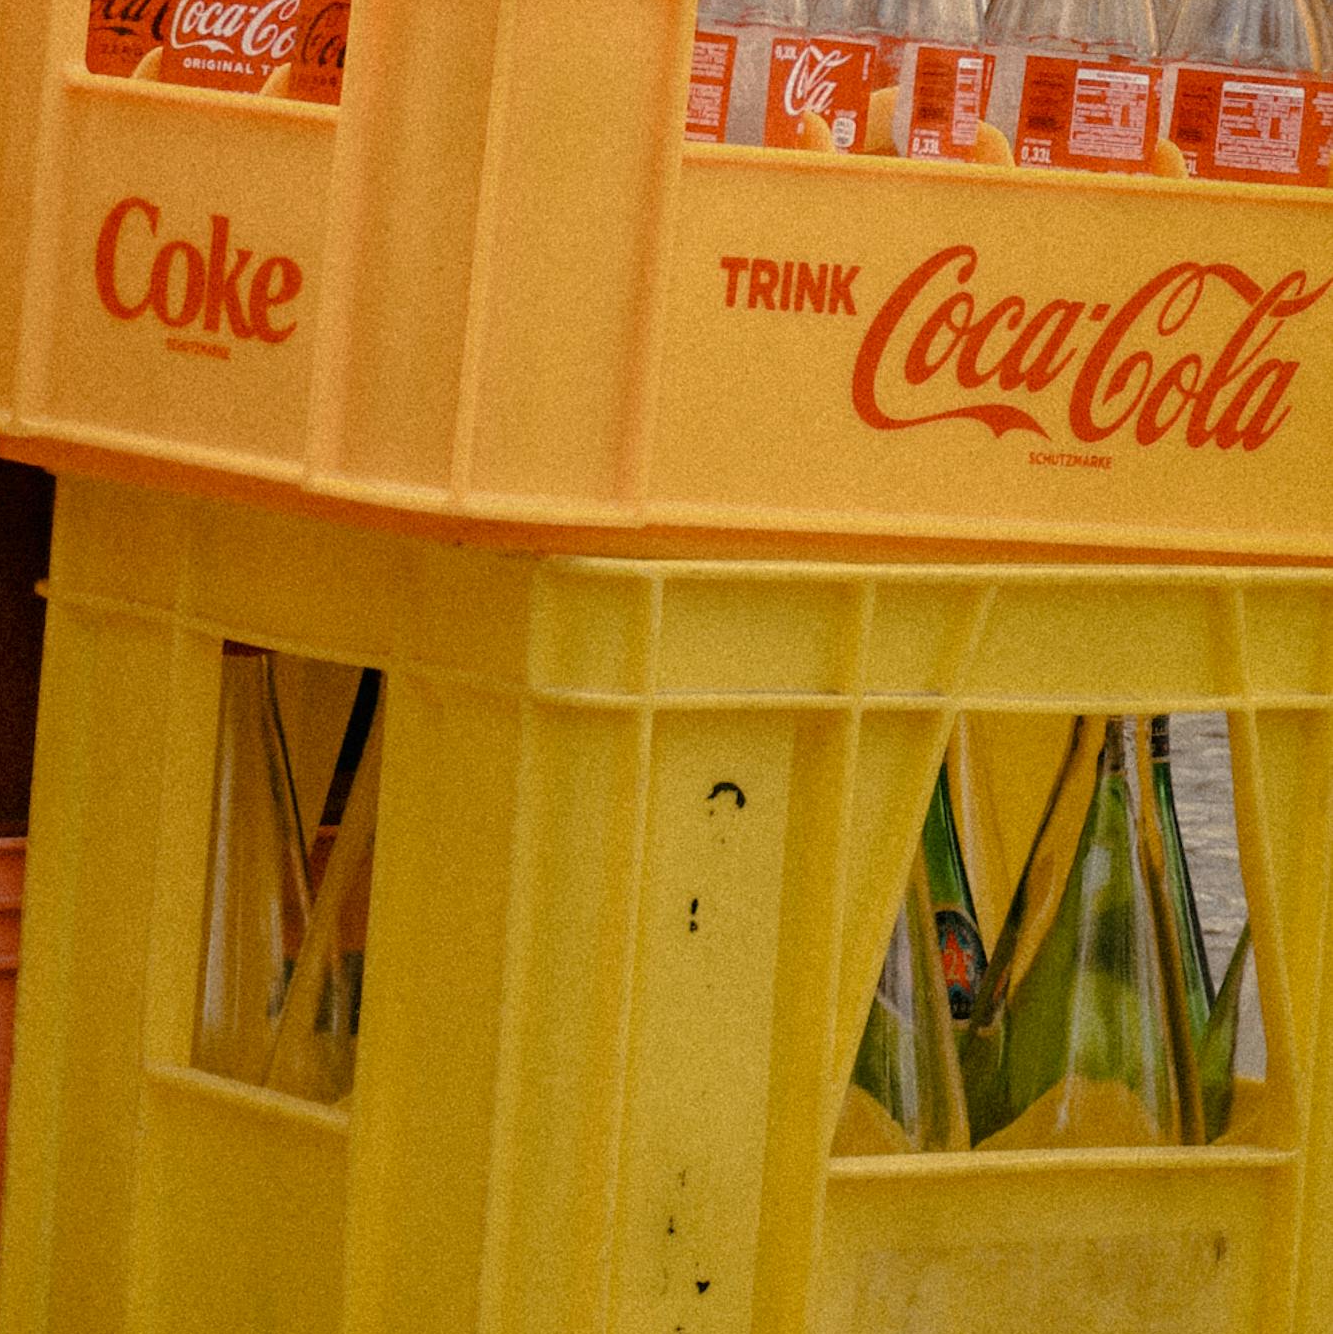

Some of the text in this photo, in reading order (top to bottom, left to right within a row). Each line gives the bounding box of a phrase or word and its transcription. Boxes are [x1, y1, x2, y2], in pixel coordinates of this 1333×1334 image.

[181, 56, 255, 76] ORIGINAL
[1020, 145, 1053, 165] 0,33L
[95, 196, 304, 344] Coke
[721, 244, 1333, 452] TRINK Coca-Cola
[1027, 451, 1115, 470] SCHUTZMARKE
